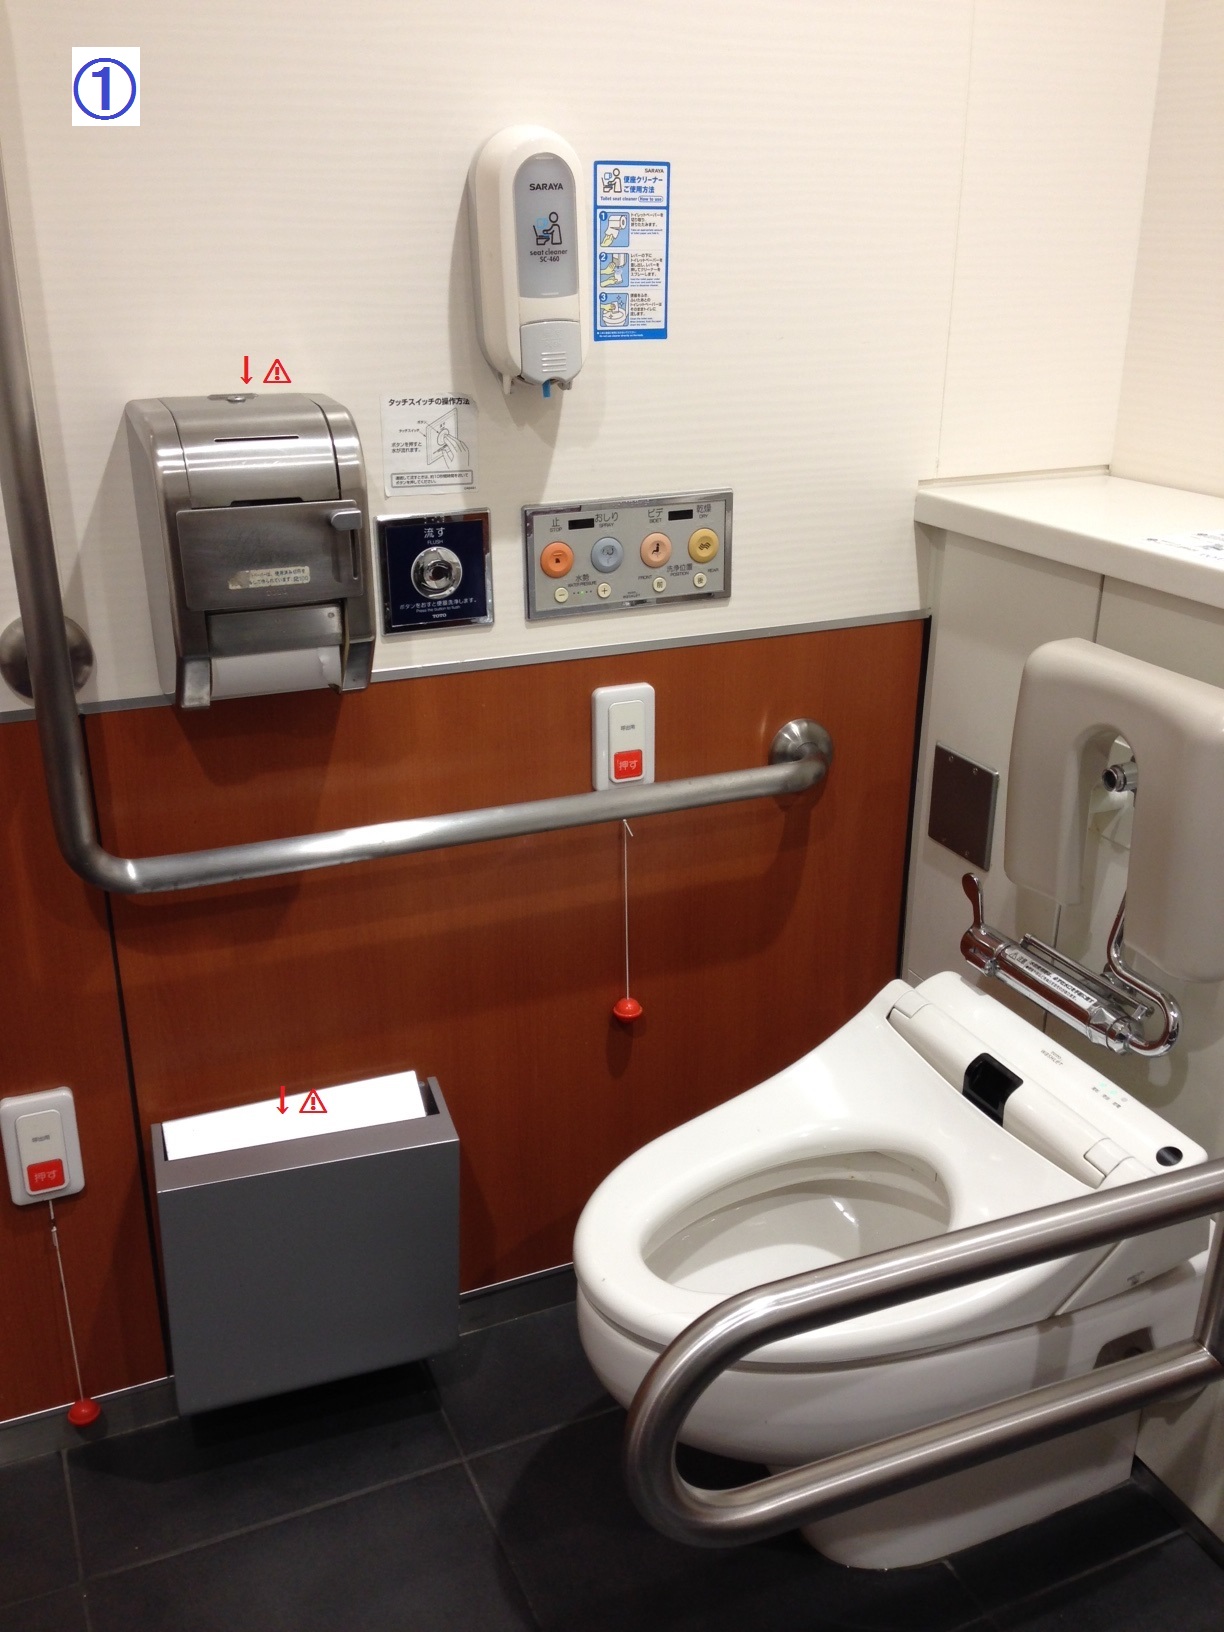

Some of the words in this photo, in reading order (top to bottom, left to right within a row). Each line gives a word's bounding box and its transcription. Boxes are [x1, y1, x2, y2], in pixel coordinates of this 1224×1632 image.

[623, 176, 663, 184] 便座クリーナー
[529, 183, 563, 191] SARAYA
[388, 397, 470, 406] タッチスイッチの操作方法
[647, 508, 664, 518] ビデ
[696, 503, 712, 513] 乾燥
[551, 517, 561, 527] 止
[595, 511, 619, 523] おしり
[424, 527, 445, 539] 流す
[666, 563, 693, 573] 洗浄位置
[619, 760, 638, 771] 押す
[34, 1169, 57, 1183] 押す
